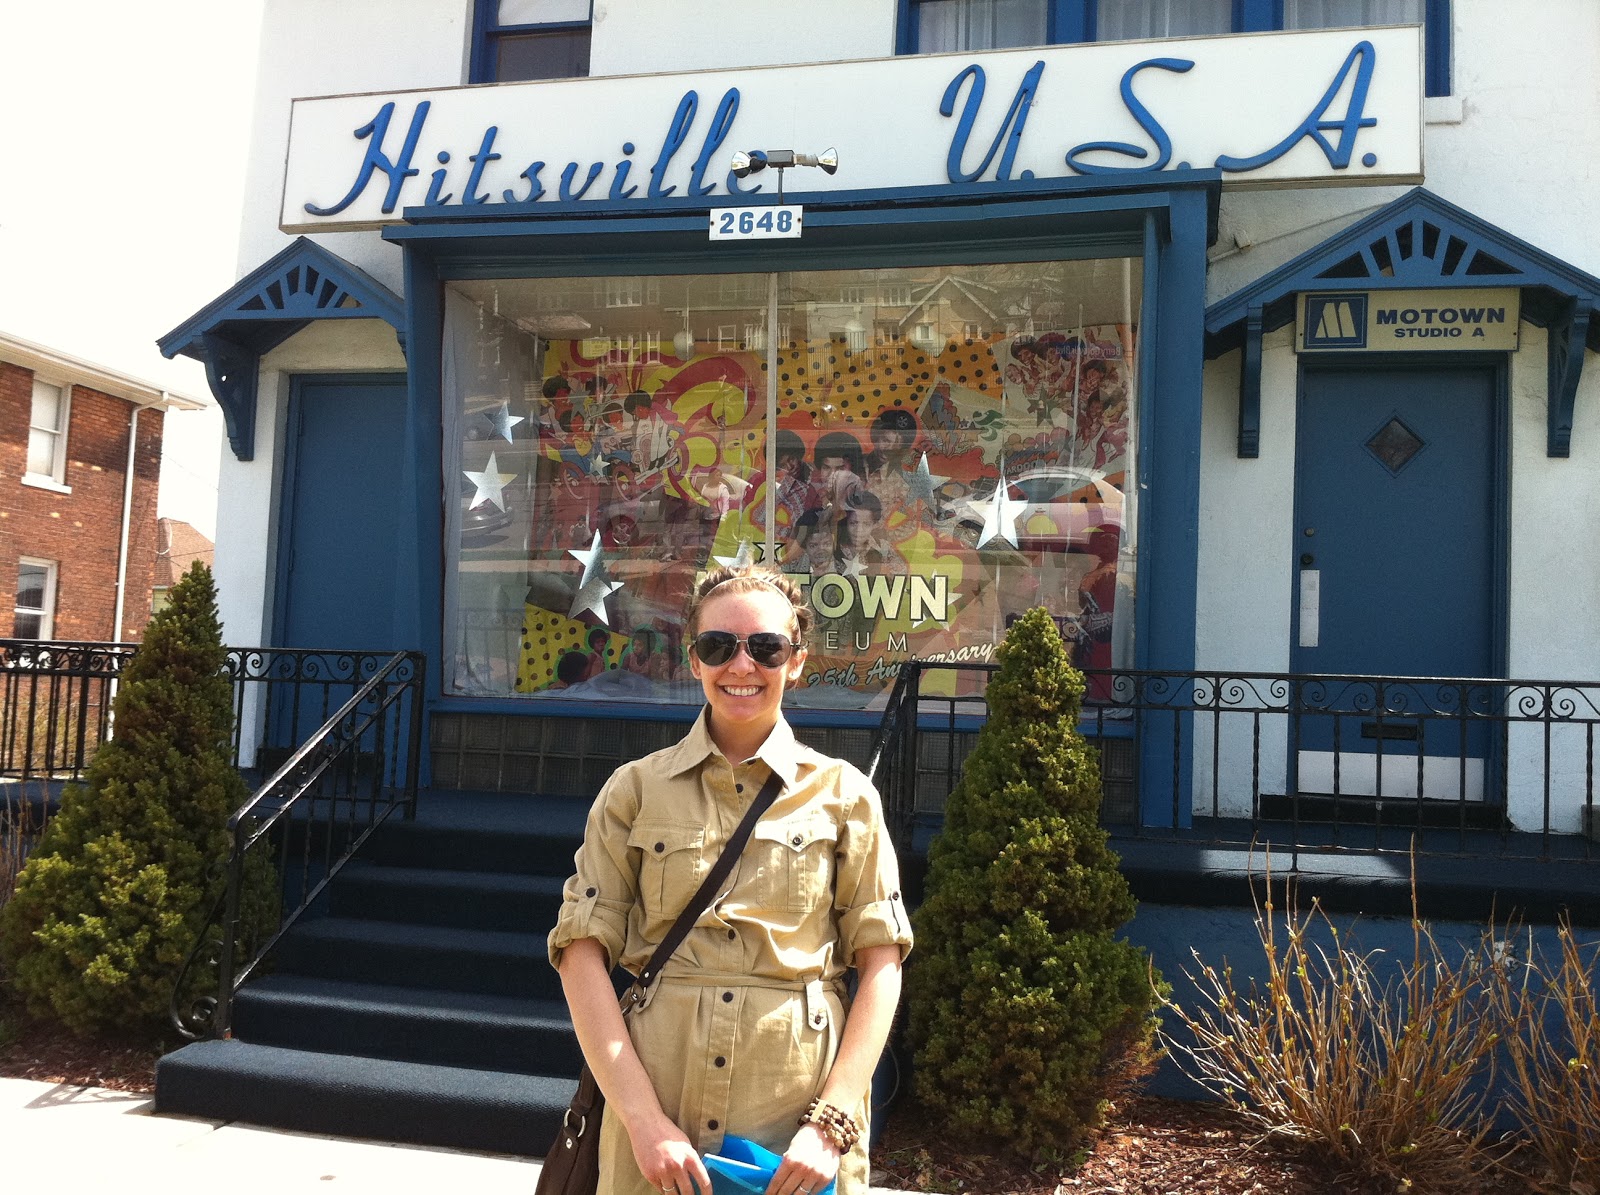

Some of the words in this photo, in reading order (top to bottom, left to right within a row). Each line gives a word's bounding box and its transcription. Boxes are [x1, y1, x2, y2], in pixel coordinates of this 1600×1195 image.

[304, 87, 768, 217] Hitsville
[719, 210, 793, 235] 2648
[1376, 307, 1505, 325] MOTOWN
[1394, 327, 1462, 338] STUDIO
[1471, 326, 1485, 338] A
[864, 642, 1000, 686] Anersary
